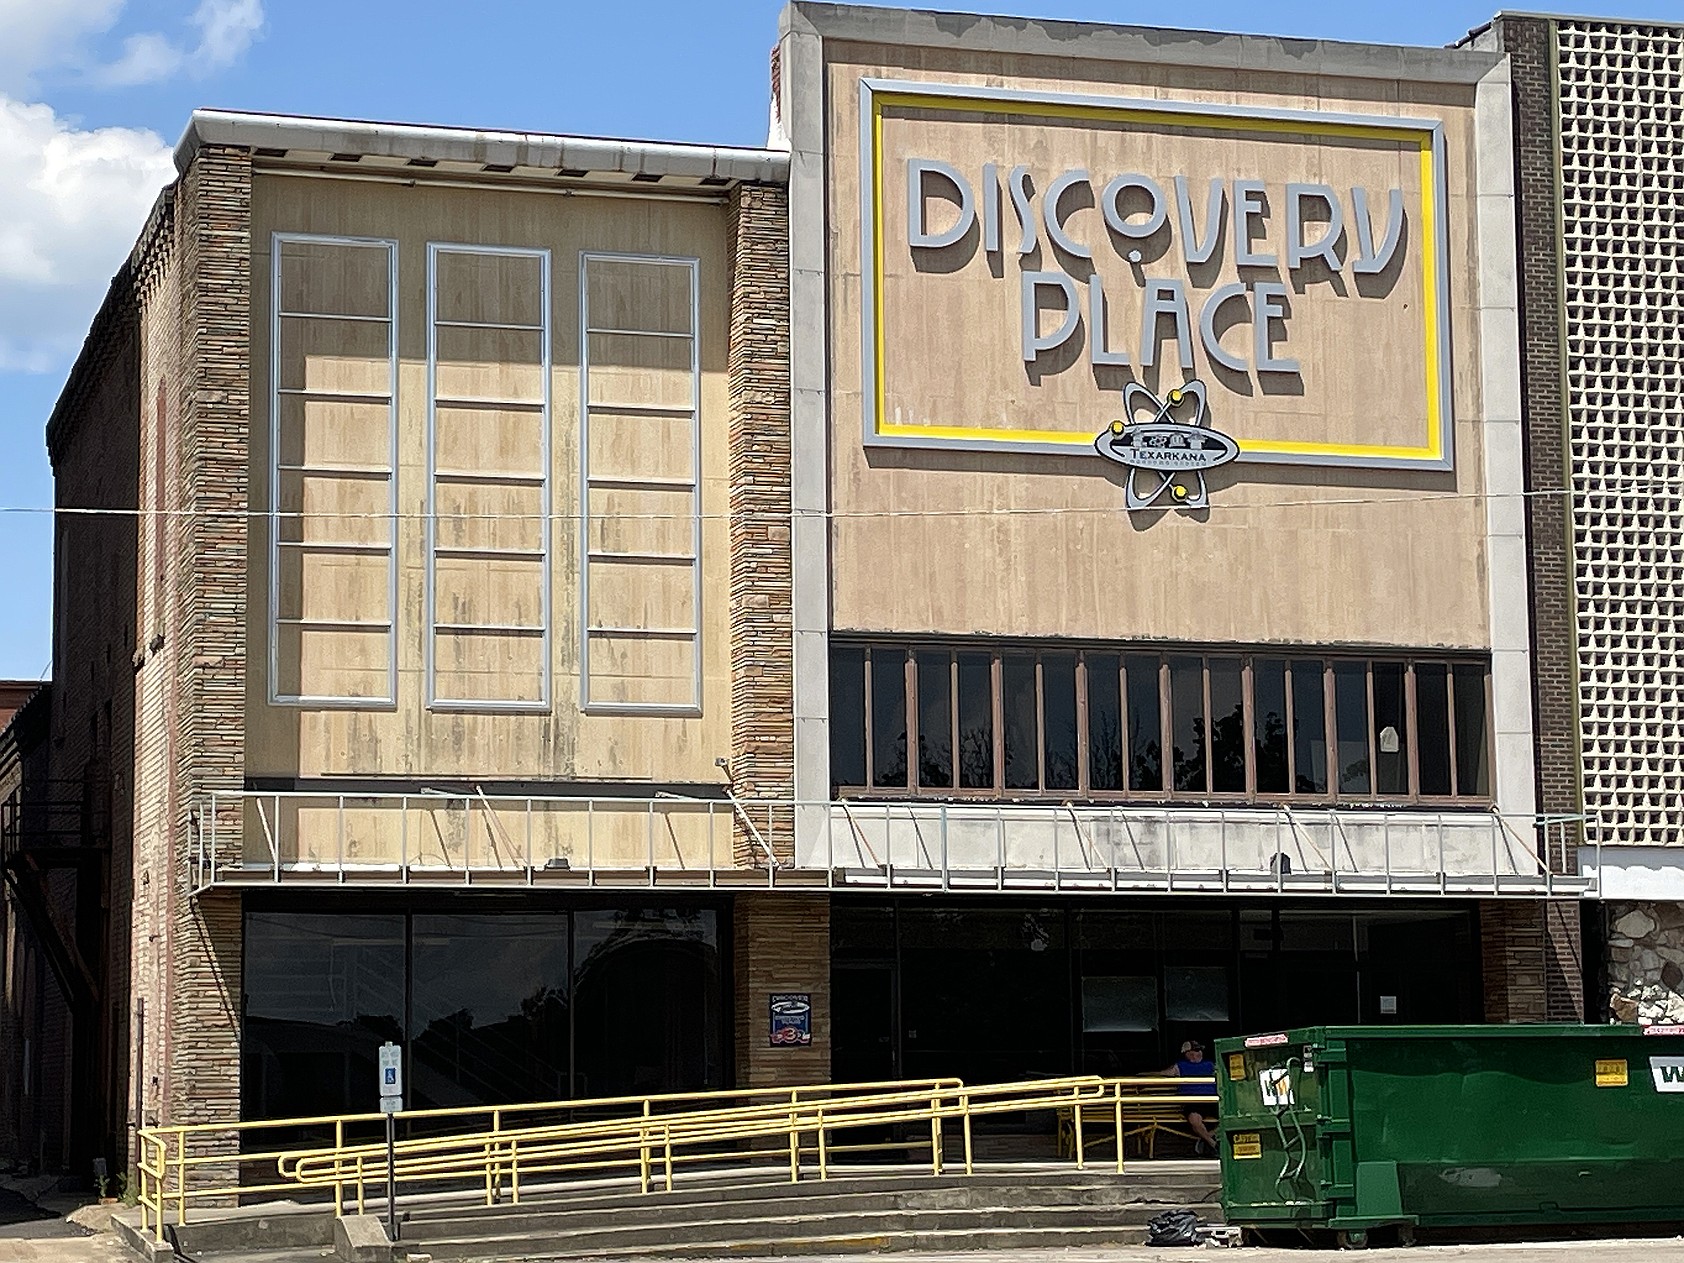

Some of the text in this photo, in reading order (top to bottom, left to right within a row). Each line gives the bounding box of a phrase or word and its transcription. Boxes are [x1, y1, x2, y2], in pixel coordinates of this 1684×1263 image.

[908, 159, 1404, 274] DISCOVERY
[1022, 272, 1299, 373] PLACE
[1130, 449, 1206, 461] TEXARKANA
